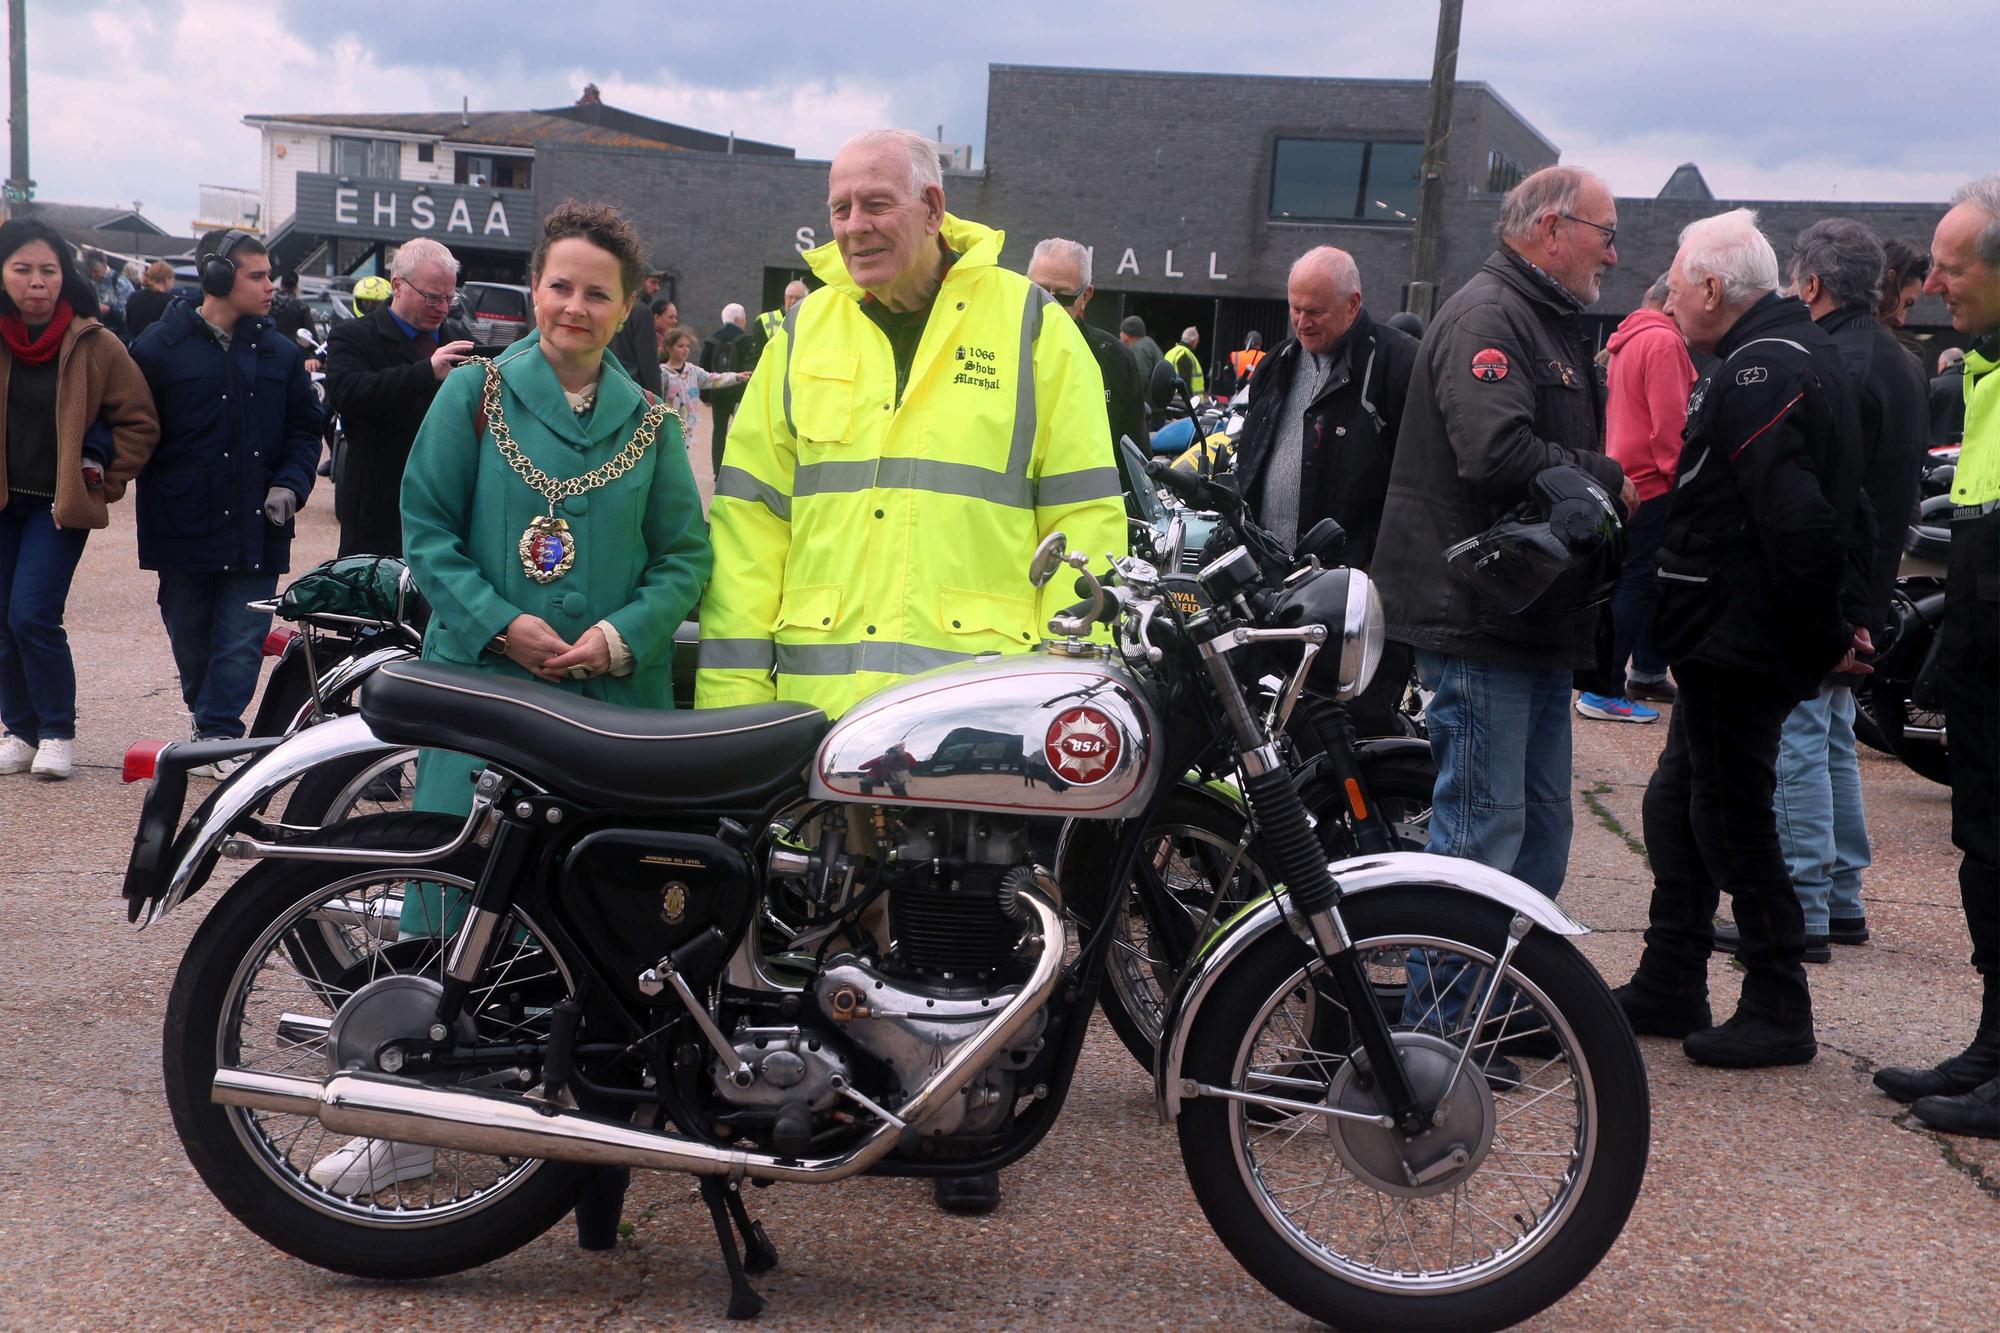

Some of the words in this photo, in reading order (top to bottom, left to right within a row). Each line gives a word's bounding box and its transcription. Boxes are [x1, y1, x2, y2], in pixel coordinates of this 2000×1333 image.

[335, 188, 511, 237] EHSAA
[969, 347, 995, 361] 1066
[964, 360, 996, 375] Show
[953, 372, 1000, 390] Marshal
[1069, 739, 1101, 752] BSA
